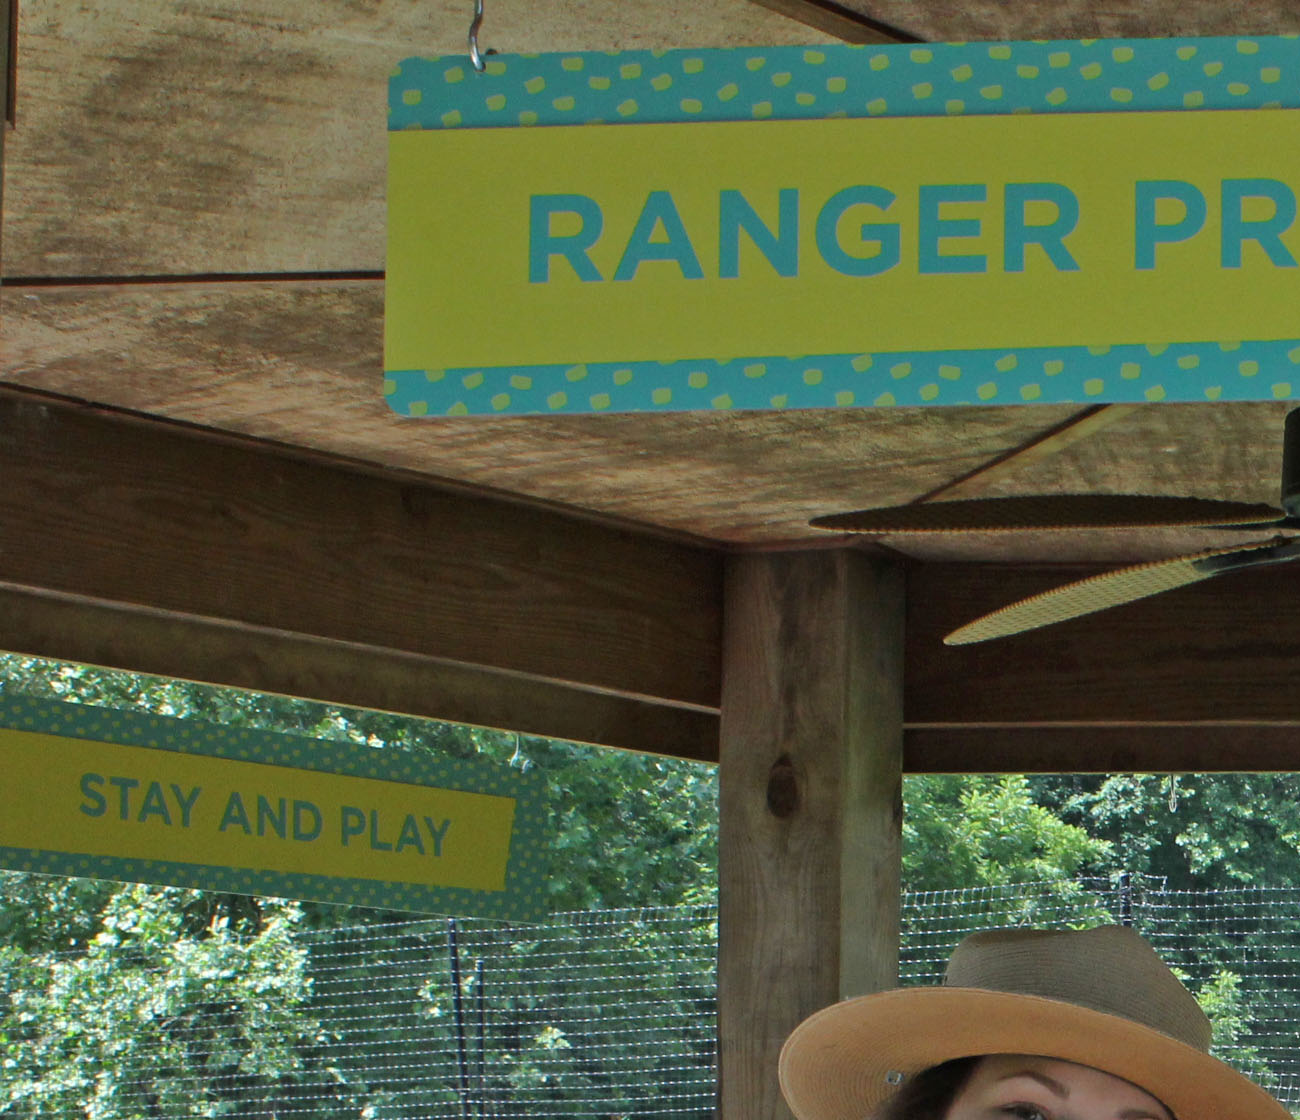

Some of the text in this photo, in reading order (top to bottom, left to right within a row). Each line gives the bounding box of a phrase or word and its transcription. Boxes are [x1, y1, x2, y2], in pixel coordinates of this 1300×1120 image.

[529, 183, 1081, 284] RANGER
[79, 772, 451, 858] STAY AND PLAY
